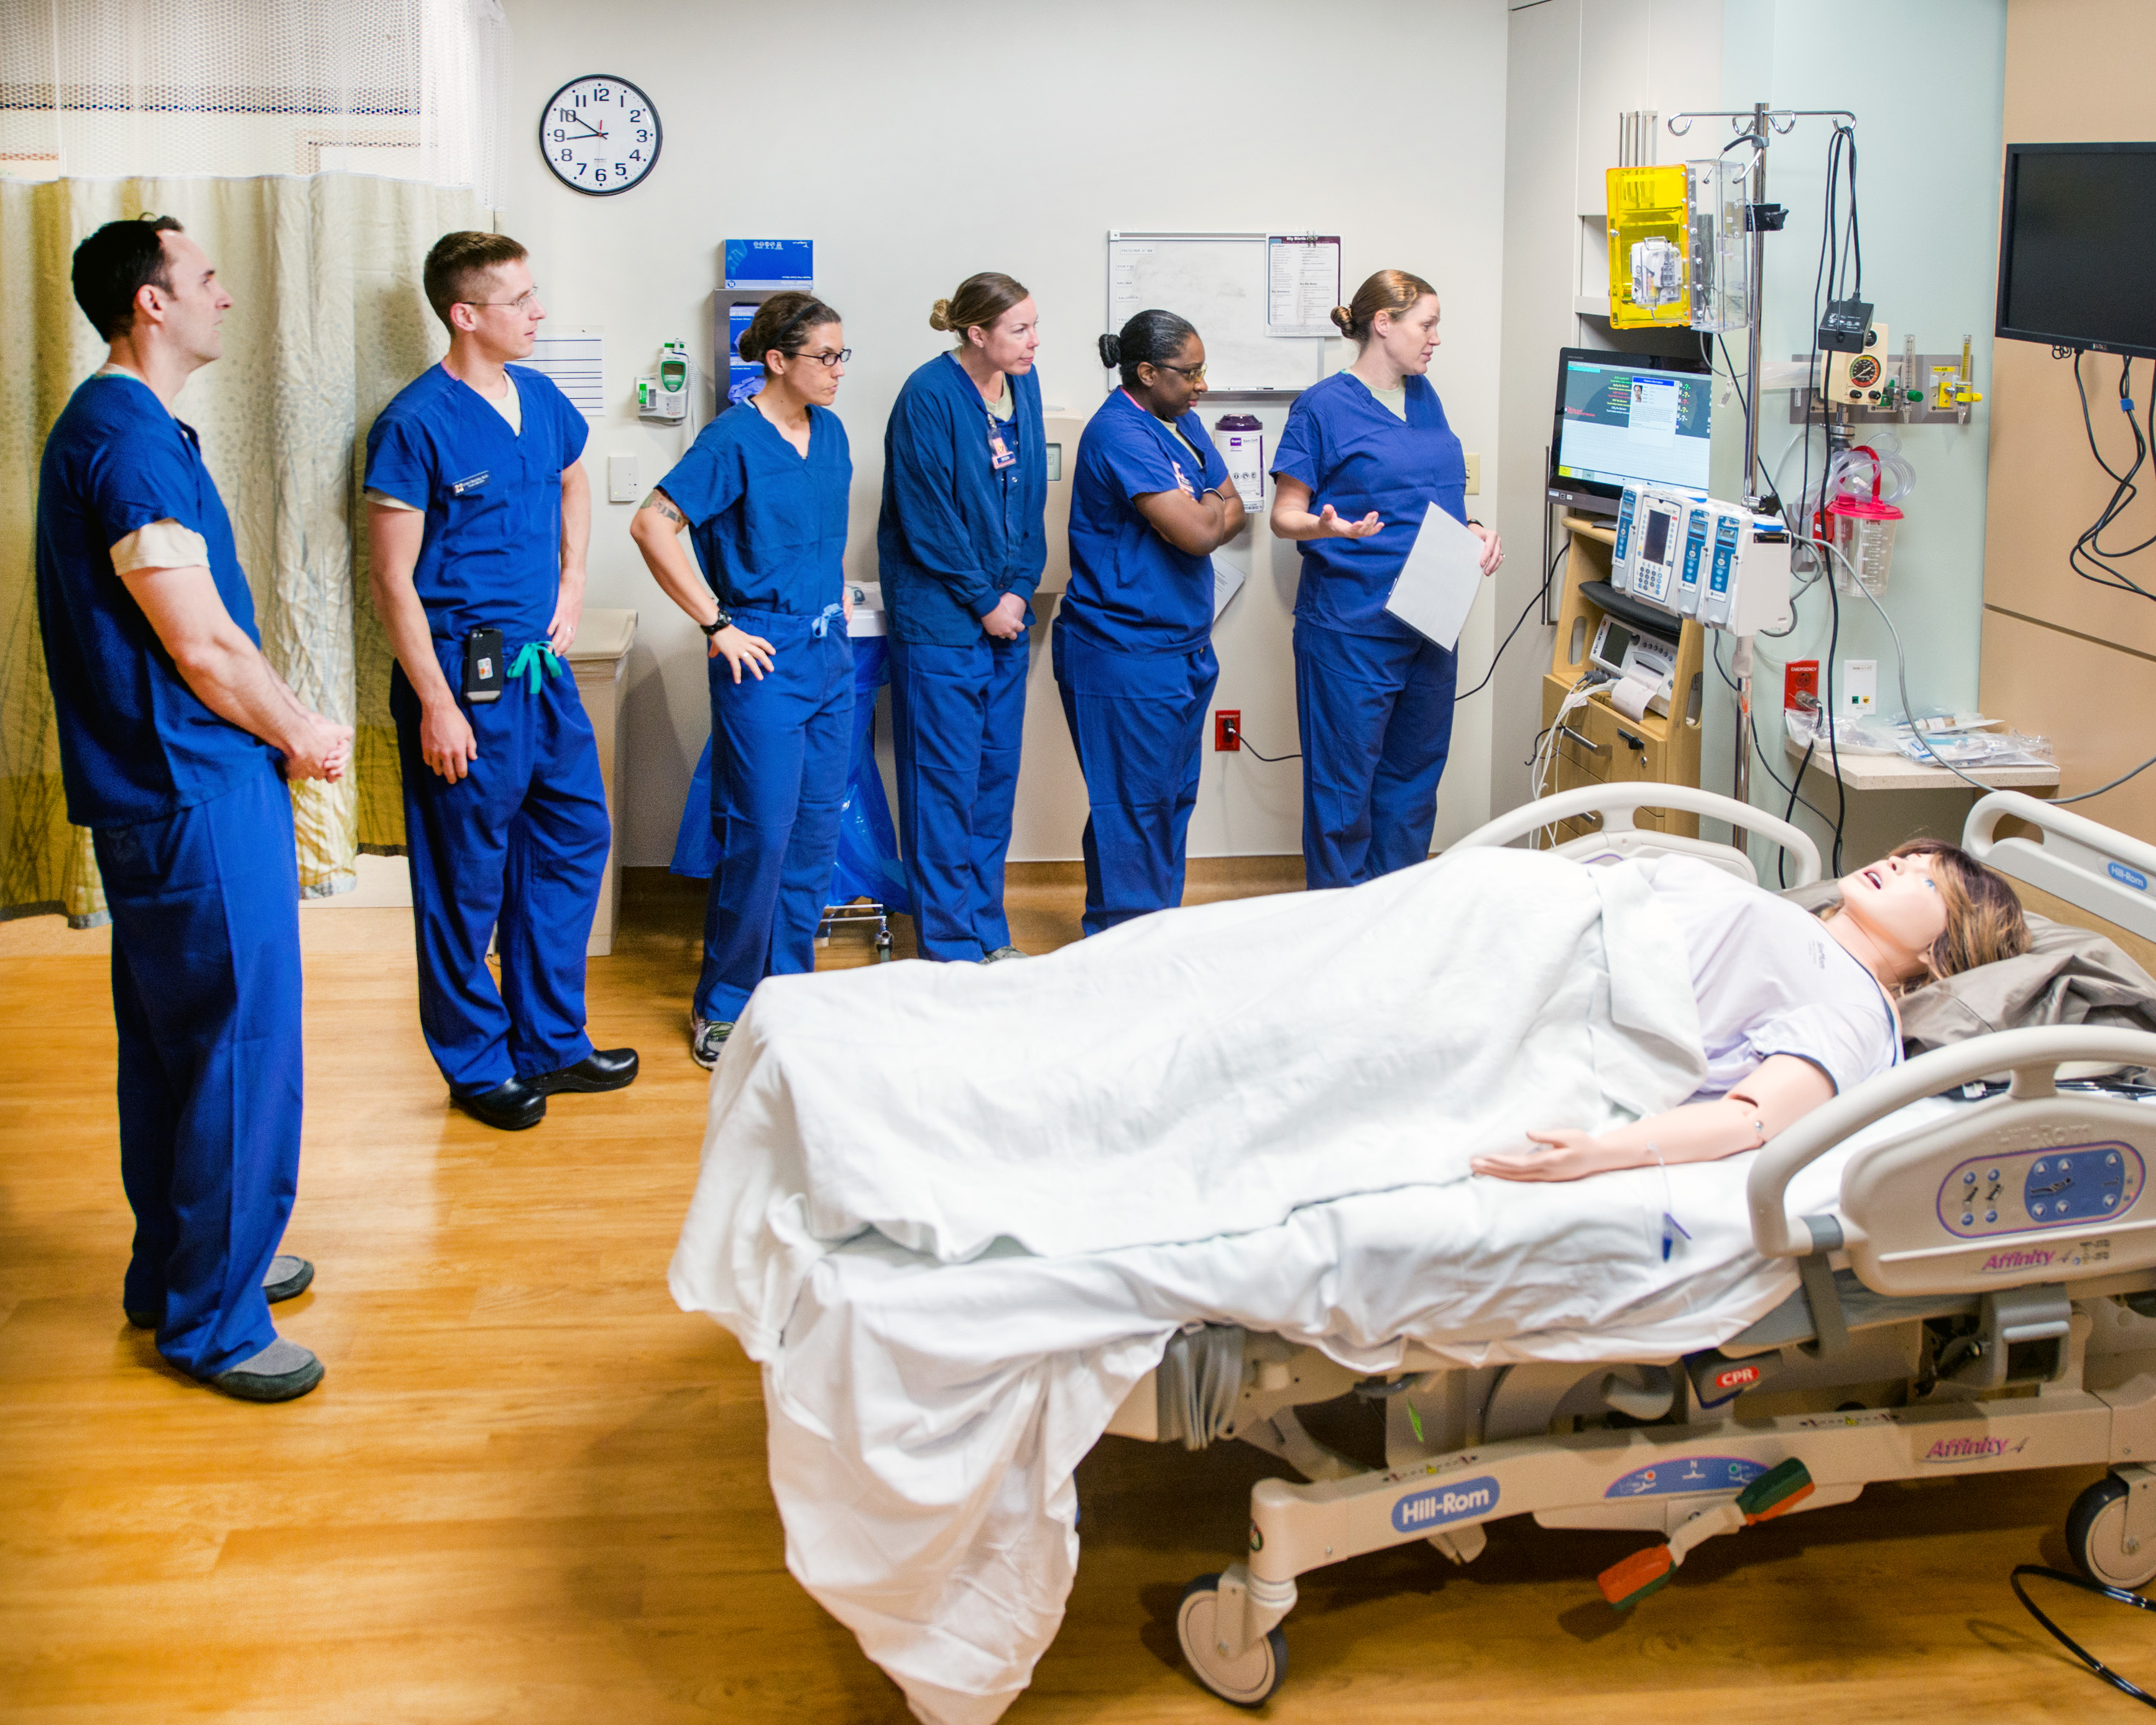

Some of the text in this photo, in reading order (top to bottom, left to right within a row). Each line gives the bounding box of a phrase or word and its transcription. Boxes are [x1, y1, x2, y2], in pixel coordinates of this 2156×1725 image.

[594, 88, 609, 101] 12
[575, 95, 586, 108] 11
[620, 95, 624, 108] 1
[559, 109, 576, 123] 10
[630, 109, 641, 123] 2
[553, 129, 566, 142] 9
[636, 129, 648, 142] 3
[561, 149, 573, 162] 8
[629, 149, 641, 162] 4
[576, 163, 587, 175] 7
[595, 168, 607, 182] 6
[614, 163, 627, 176] 5
[2111, 865, 2144, 887] Hill-Rom
[1981, 1248, 2056, 1271] Affinity
[1721, 1368, 1754, 1386] CPR
[1926, 1435, 2010, 1458] Affinity
[1402, 1489, 1489, 1525] Hill-Rom
